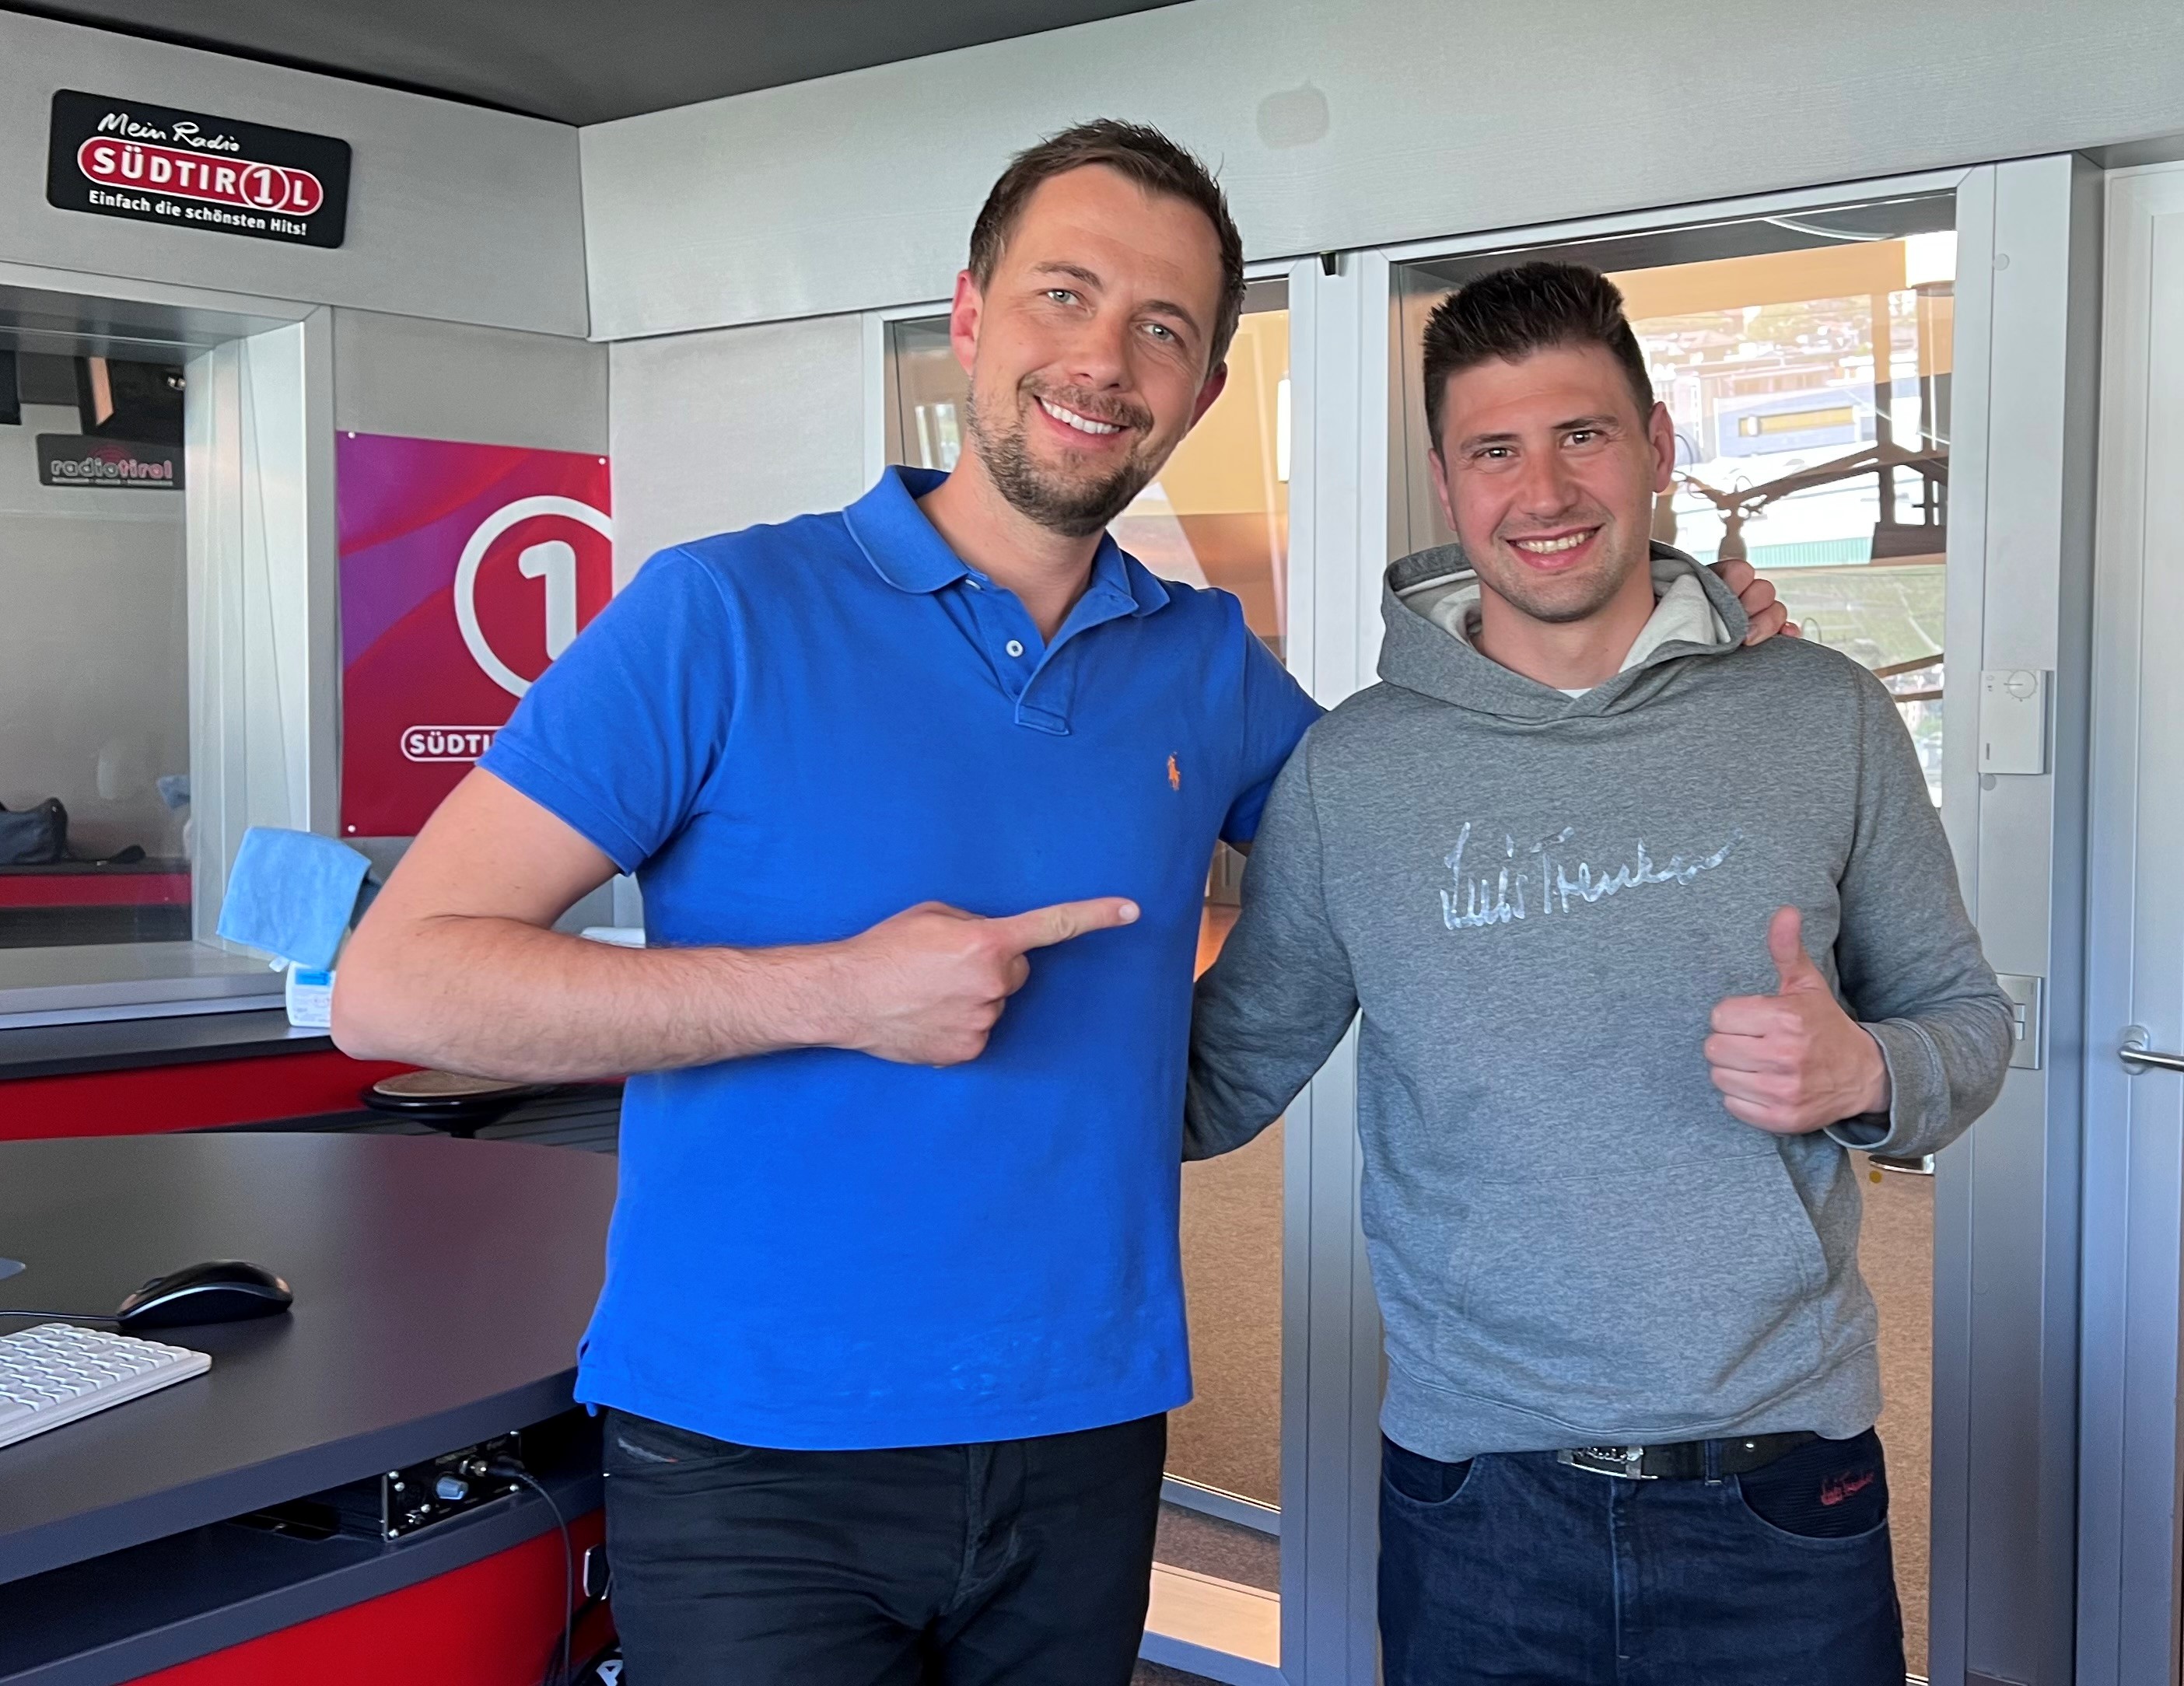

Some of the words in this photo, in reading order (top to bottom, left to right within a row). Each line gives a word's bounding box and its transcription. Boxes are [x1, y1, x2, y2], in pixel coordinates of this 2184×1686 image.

[97, 113, 166, 139] Mein
[172, 121, 240, 152] Radio
[89, 191, 151, 212] Einfach
[155, 201, 181, 217] die
[186, 205, 265, 229] schönsten
[270, 217, 307, 236] Hits!
[518, 540, 577, 661] 1
[409, 731, 490, 754] SÜDTI
